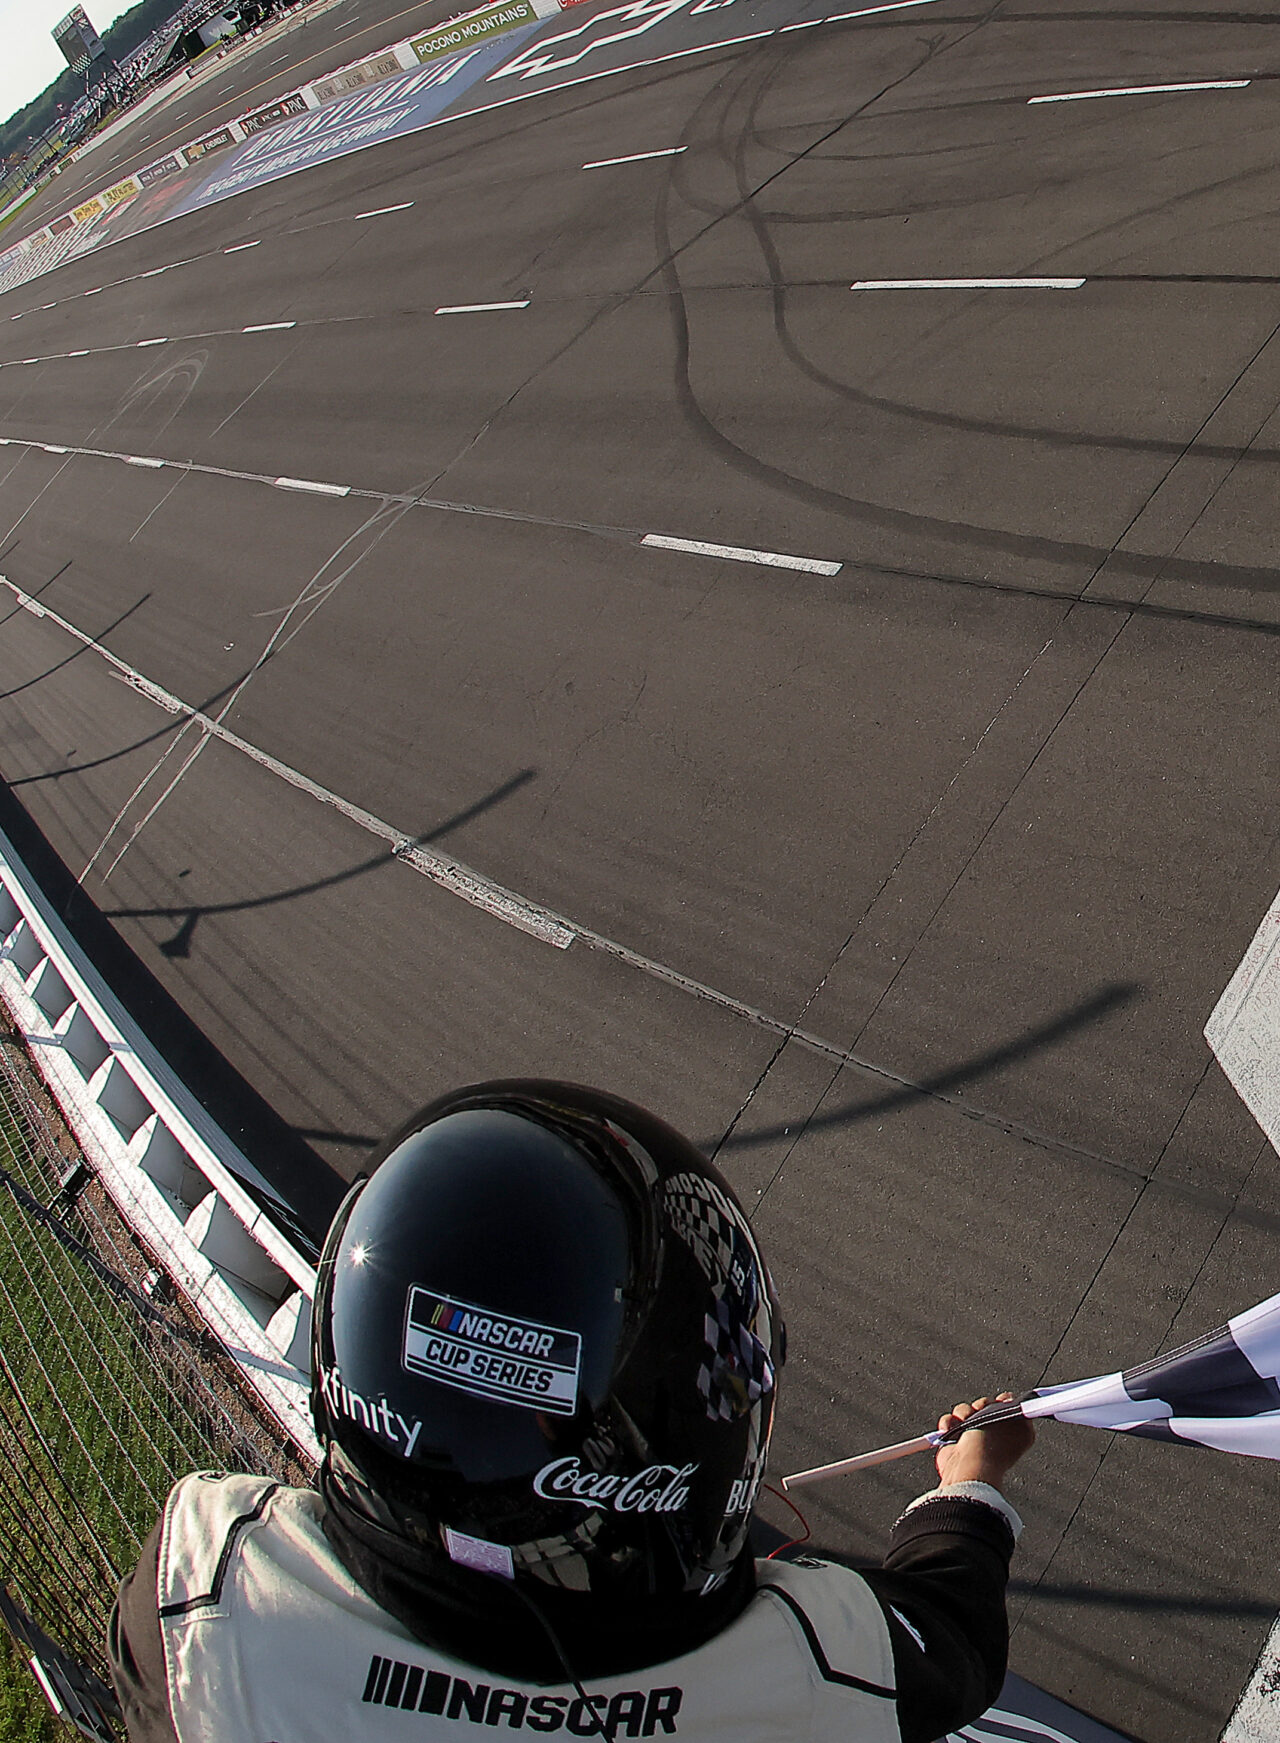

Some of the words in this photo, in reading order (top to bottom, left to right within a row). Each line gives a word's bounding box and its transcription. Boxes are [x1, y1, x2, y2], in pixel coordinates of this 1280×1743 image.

[416, 32, 461, 57] POCONO
[461, 4, 526, 39] MOUNTAINS
[246, 117, 263, 133] PNC
[289, 97, 307, 114] PNC
[458, 1313, 555, 1358] NASCAR
[425, 1338, 471, 1369] CUP
[470, 1354, 554, 1393] SERIES
[319, 1363, 422, 1457] xfinity
[533, 1456, 700, 1513] Coca-Cola
[446, 1678, 683, 1738] NASCAR
